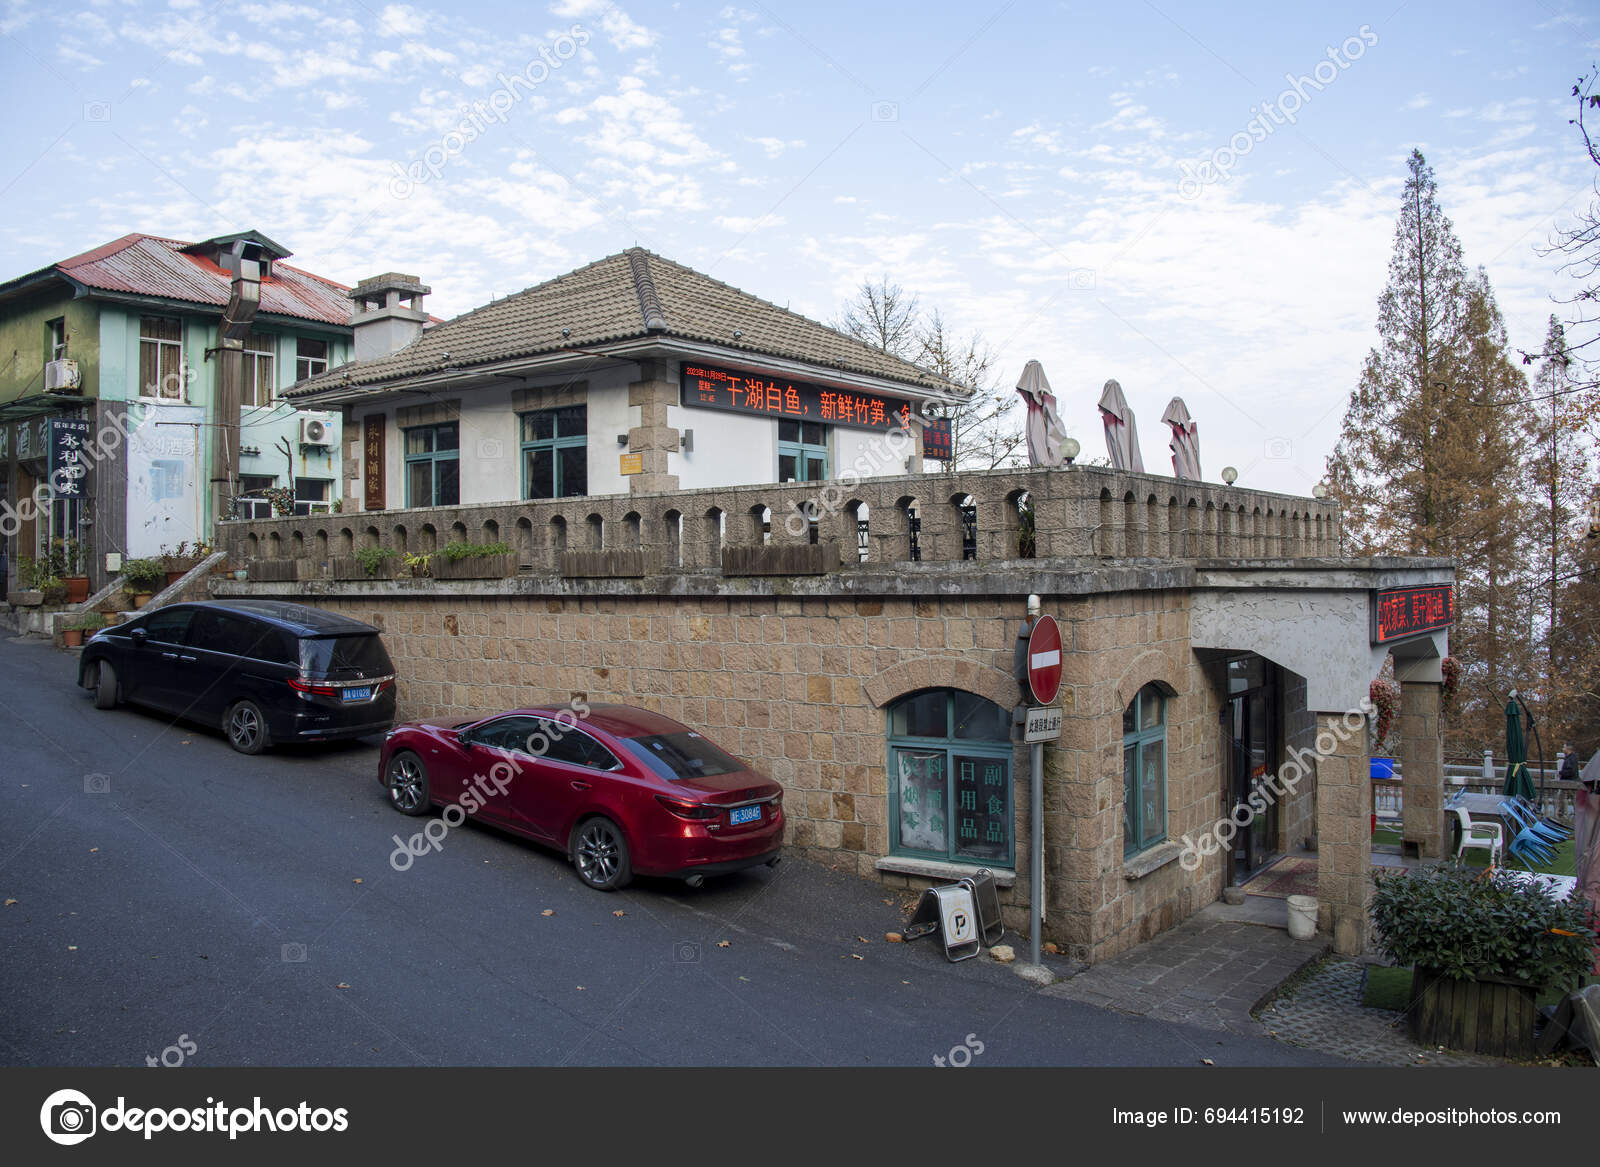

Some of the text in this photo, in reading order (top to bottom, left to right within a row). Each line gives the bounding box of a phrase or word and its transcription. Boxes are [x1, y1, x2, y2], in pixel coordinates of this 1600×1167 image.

[59, 433, 80, 495] 永利酒家
[961, 762, 978, 839] 日用品
[984, 764, 1004, 843] 副食品
